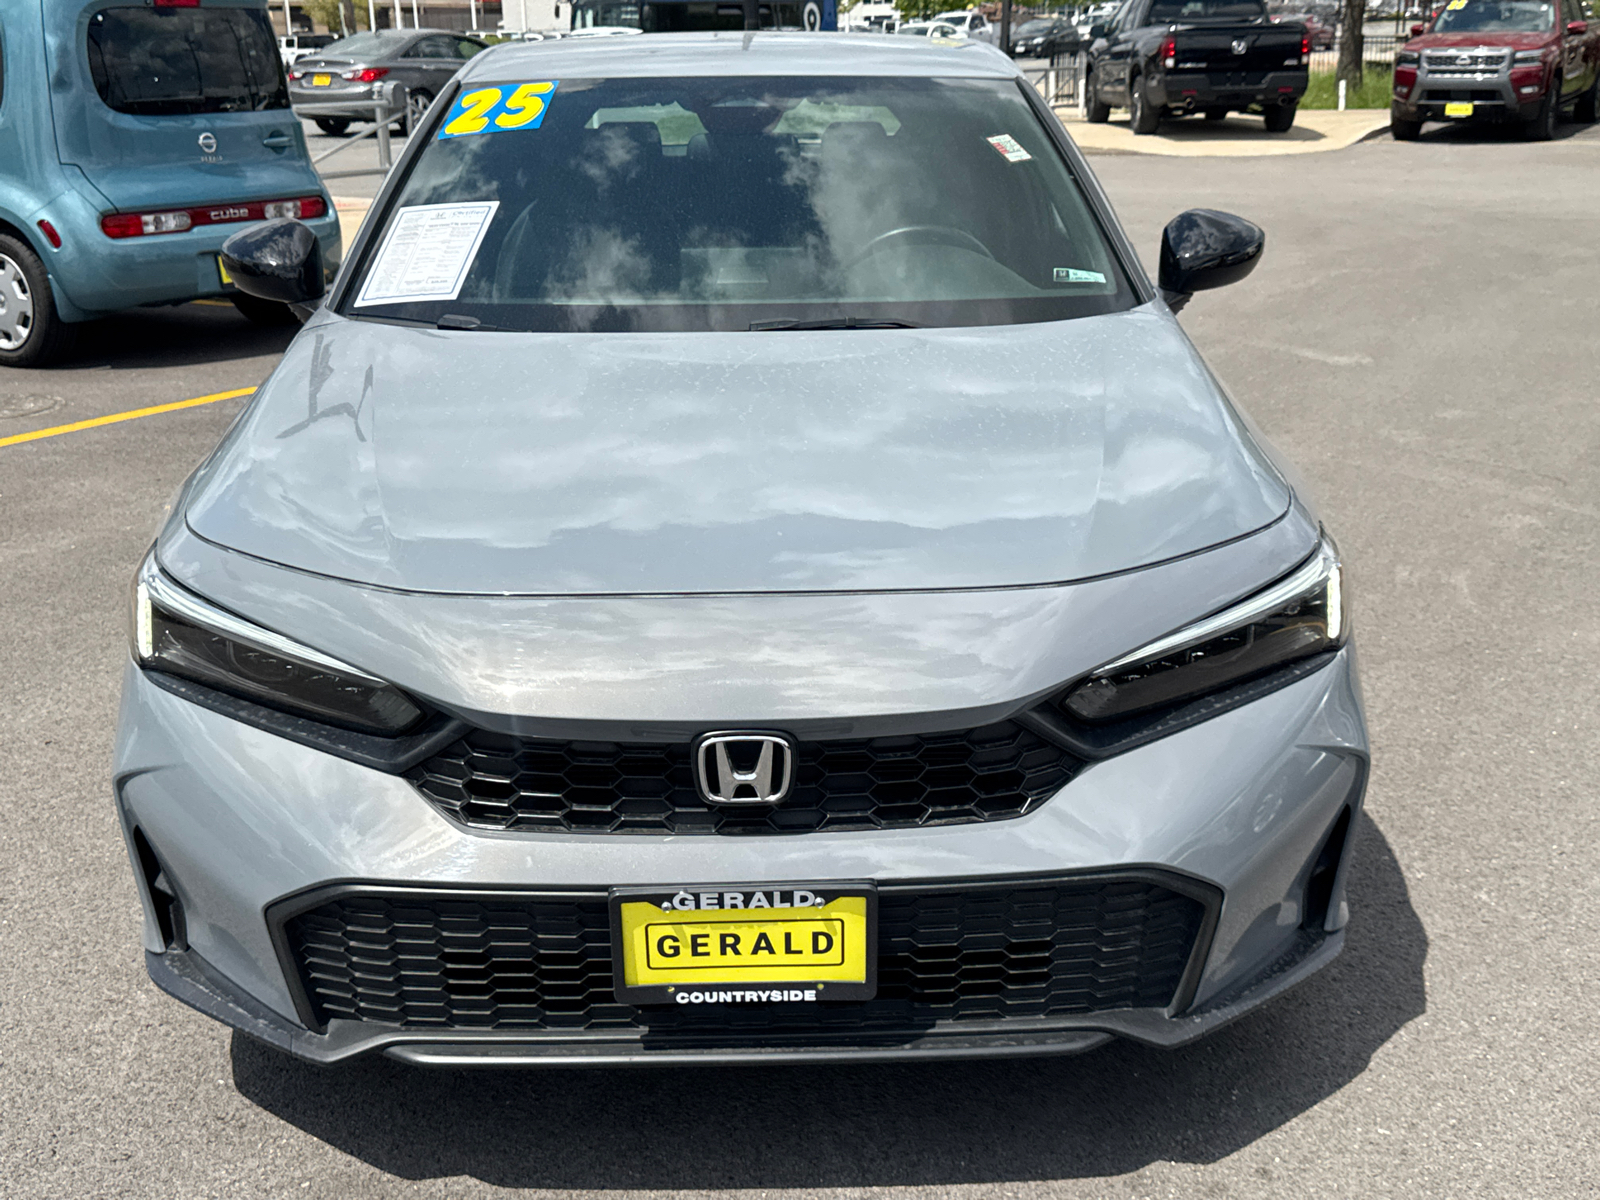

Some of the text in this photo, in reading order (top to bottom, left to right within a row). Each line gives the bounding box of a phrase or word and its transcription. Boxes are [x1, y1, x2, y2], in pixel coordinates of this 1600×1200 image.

[444, 81, 555, 135] 25
[210, 207, 249, 220] cube
[672, 890, 816, 911] GERALD
[656, 930, 834, 958] GERALD
[675, 989, 817, 1004] COUNTRYSIDE
